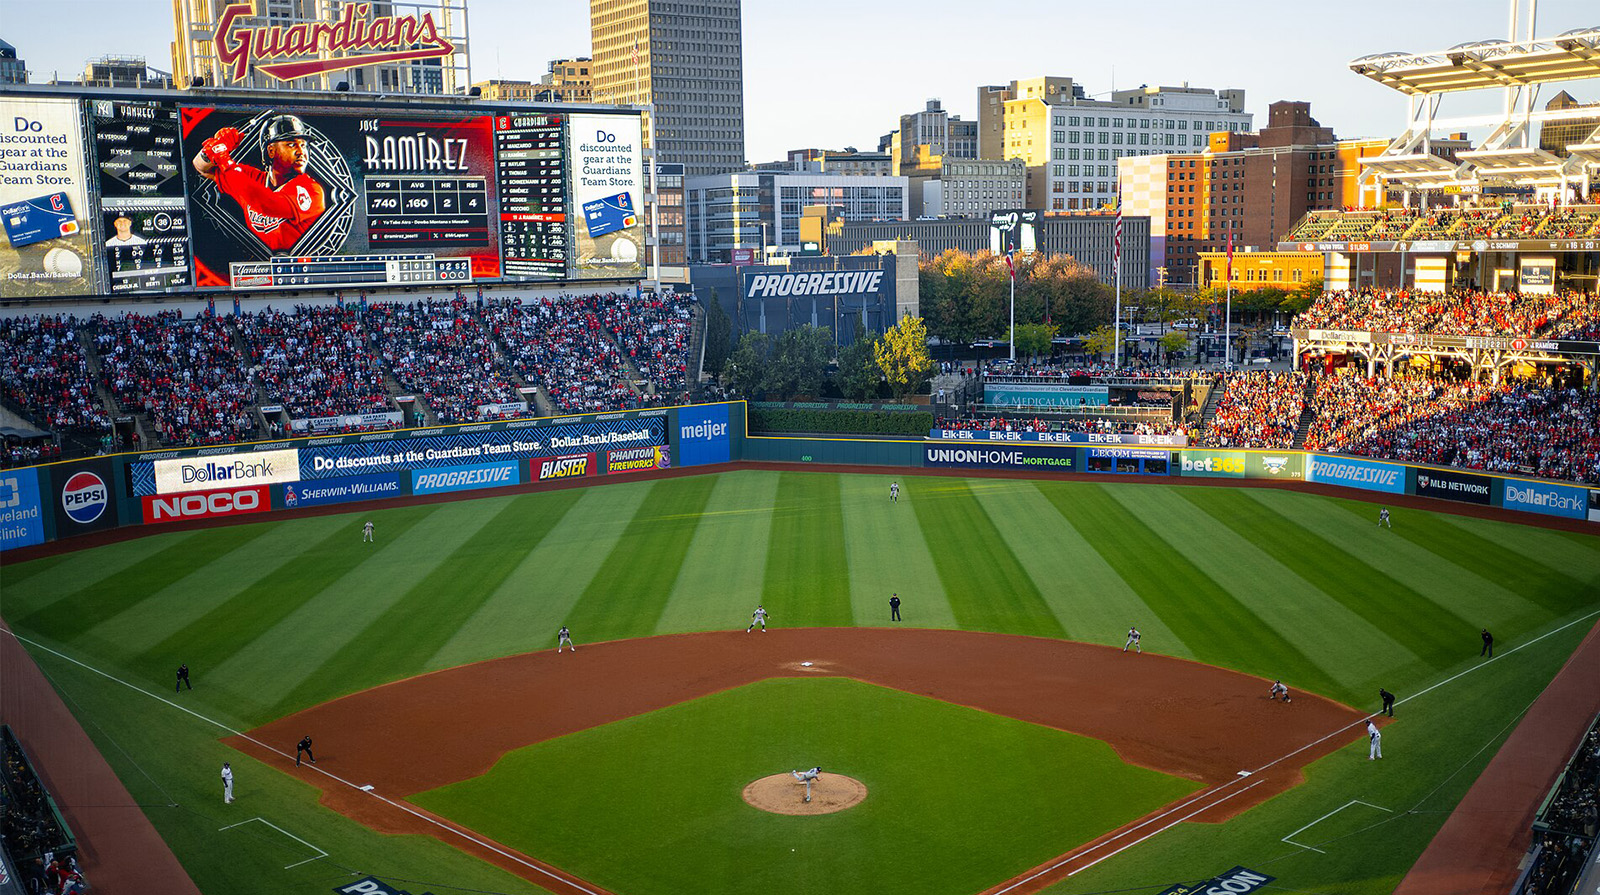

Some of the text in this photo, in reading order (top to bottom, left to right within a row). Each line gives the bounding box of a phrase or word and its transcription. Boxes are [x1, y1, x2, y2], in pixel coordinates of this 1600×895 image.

[213, 3, 456, 84] Guardians
[120, 106, 155, 119] YANKEES
[14, 116, 43, 132] Do
[514, 116, 548, 127] GUARDIANS
[0, 133, 68, 144] iscounted
[596, 130, 616, 143] Do
[0, 148, 68, 159] gear at the
[362, 132, 469, 170] RAMÍREZ
[580, 143, 632, 152] discounted
[0, 160, 68, 171] Guardians
[583, 155, 632, 165] gear at the
[583, 166, 631, 175] Guardians
[36, 174, 74, 184] Store.
[581, 177, 635, 186] Team Store.
[372, 199, 477, 208] .740 .160 2 4
[237, 265, 269, 275] Yankees
[748, 271, 884, 297] PROGRESSIVE
[1322, 332, 1356, 340] DollarBank
[1535, 341, 1559, 350] RAMÍREZ
[139, 452, 179, 460] PROGRESSIVE
[197, 447, 235, 455] PROGRESSIVE
[253, 442, 292, 450] PROGRESSIVE
[308, 437, 344, 446] PROGRESSIVE
[360, 433, 395, 441] PROGRESSIVE
[506, 420, 537, 428] PROGRESSIVE
[552, 416, 582, 424] PROGRESSIVE
[681, 422, 727, 440] meijer
[314, 429, 650, 471] Do discounts at the Guardians Team Store. Dollar.Bank/Baseball
[609, 448, 654, 461] PHANTOM
[540, 457, 587, 479] BLASTER
[609, 459, 654, 471] FIREWORKS
[1023, 457, 1071, 466] MORTGAGE
[1182, 456, 1245, 473] bet365
[182, 458, 273, 484] DollarBank
[415, 466, 511, 490] PROGRESSIVE
[1308, 460, 1399, 485] PROGRESSIVE
[1430, 479, 1488, 495] MLB NETWORK
[65, 490, 104, 506] PEPSI
[152, 490, 259, 519] NOCO
[1506, 486, 1584, 511] DollarBank
[0, 526, 27, 540] linic
